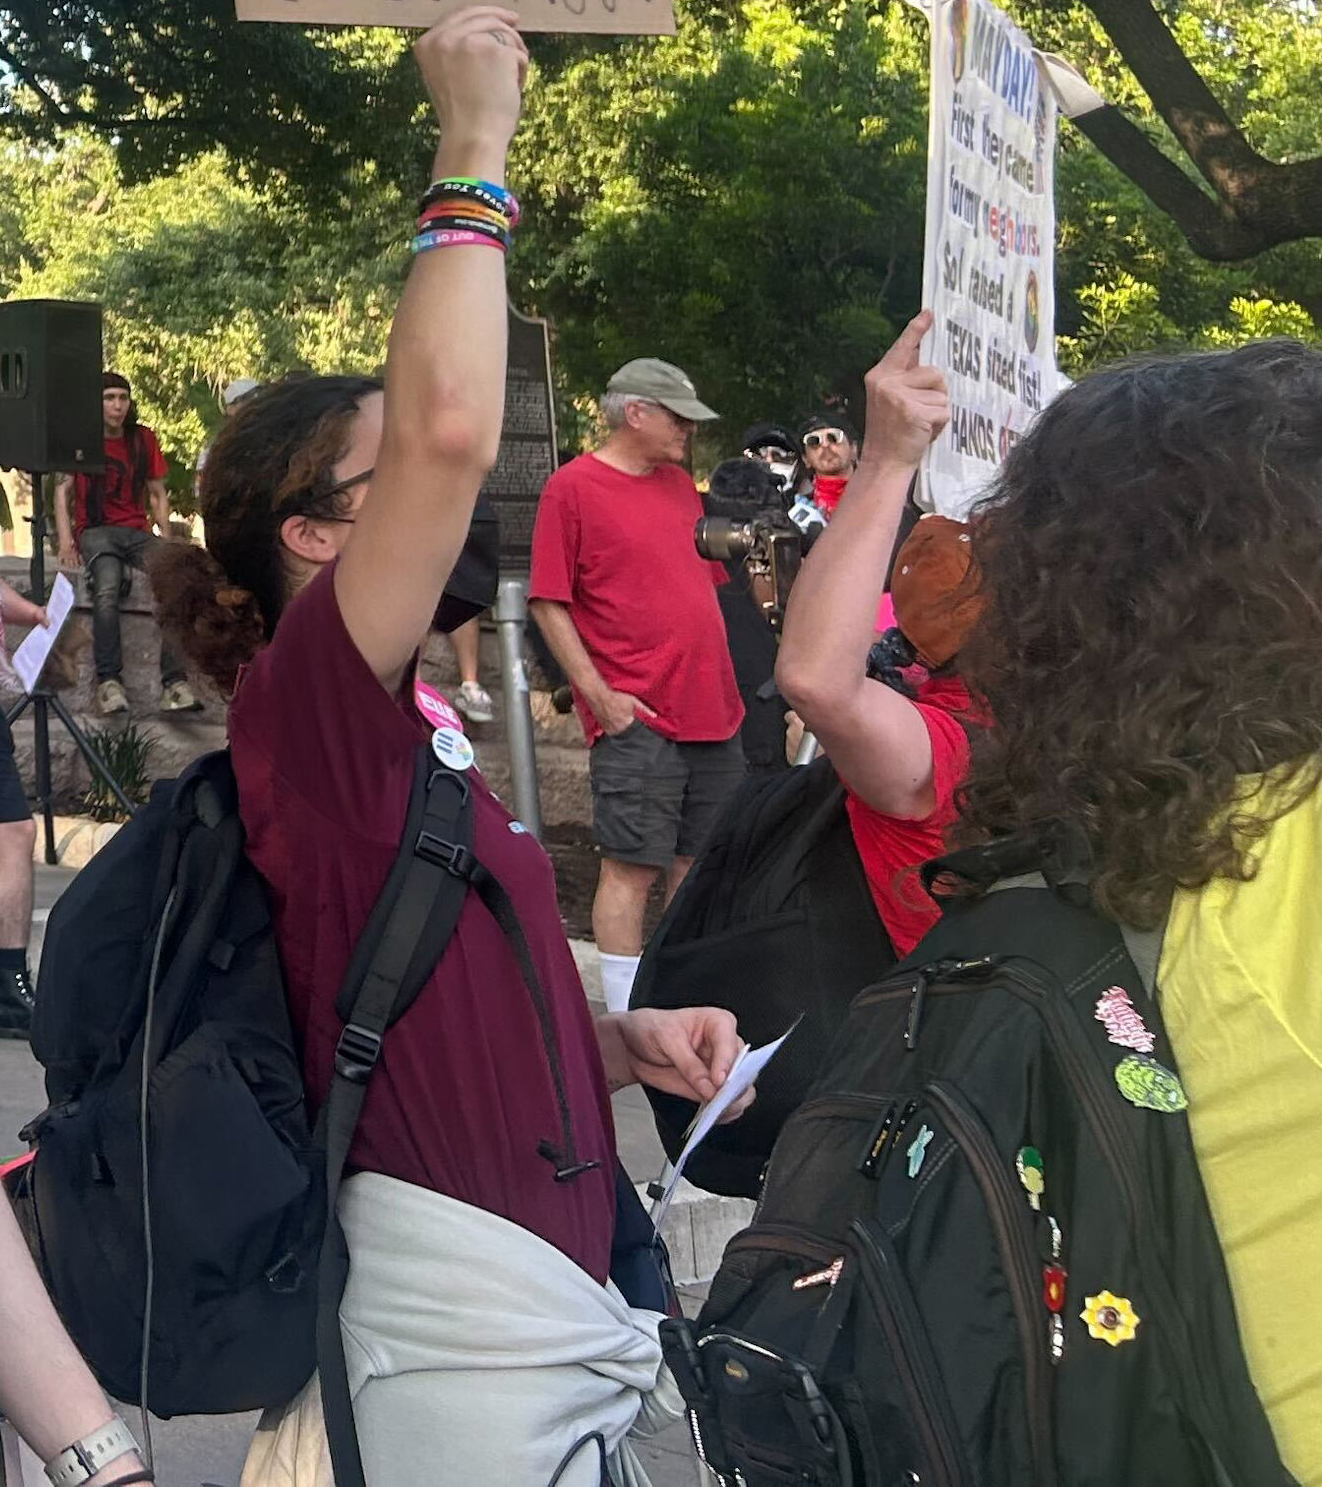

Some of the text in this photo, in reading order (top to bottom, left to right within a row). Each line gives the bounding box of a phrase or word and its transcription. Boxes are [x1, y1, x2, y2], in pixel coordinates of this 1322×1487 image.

[950, 91, 975, 152] First
[1005, 144, 1034, 194] came
[968, 259, 1005, 319] raised
[946, 318, 981, 382] TEXAS
[986, 336, 1016, 395] sized
[951, 402, 997, 466] HANDS
